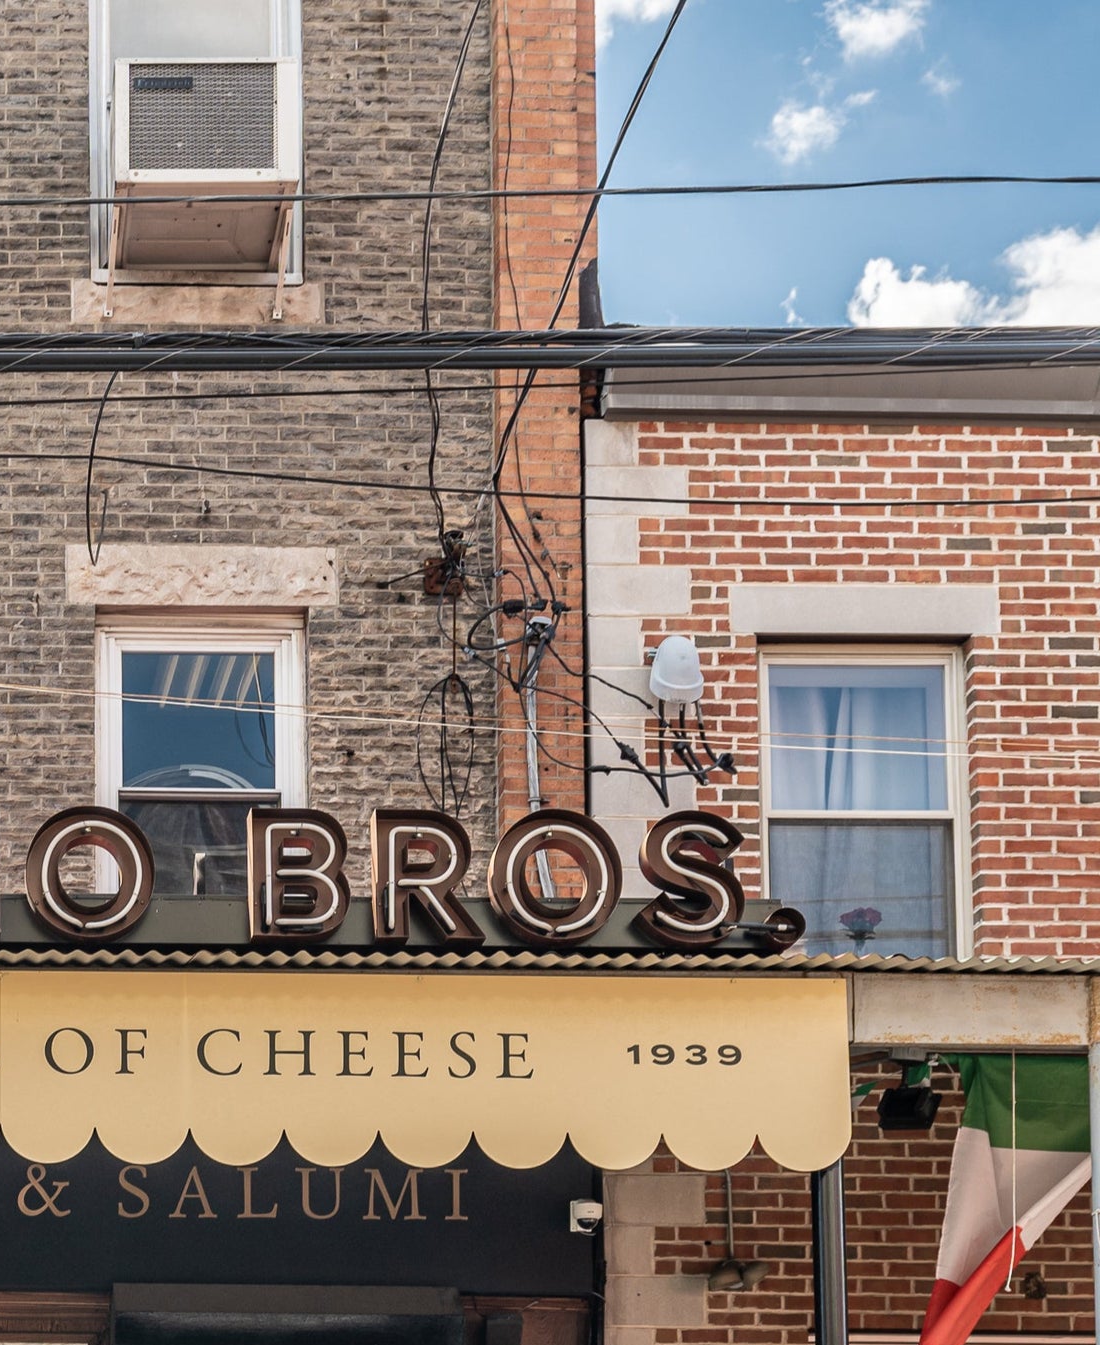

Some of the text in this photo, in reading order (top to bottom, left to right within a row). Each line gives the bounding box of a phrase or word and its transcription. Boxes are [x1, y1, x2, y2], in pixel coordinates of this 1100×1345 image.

[247, 808, 806, 953] BROS.
[43, 1026, 149, 1076] OF
[196, 1028, 535, 1081] CHEESE
[626, 1044, 744, 1066] 1939
[16, 1163, 71, 1218] &
[116, 1164, 469, 1222] SALUMI
